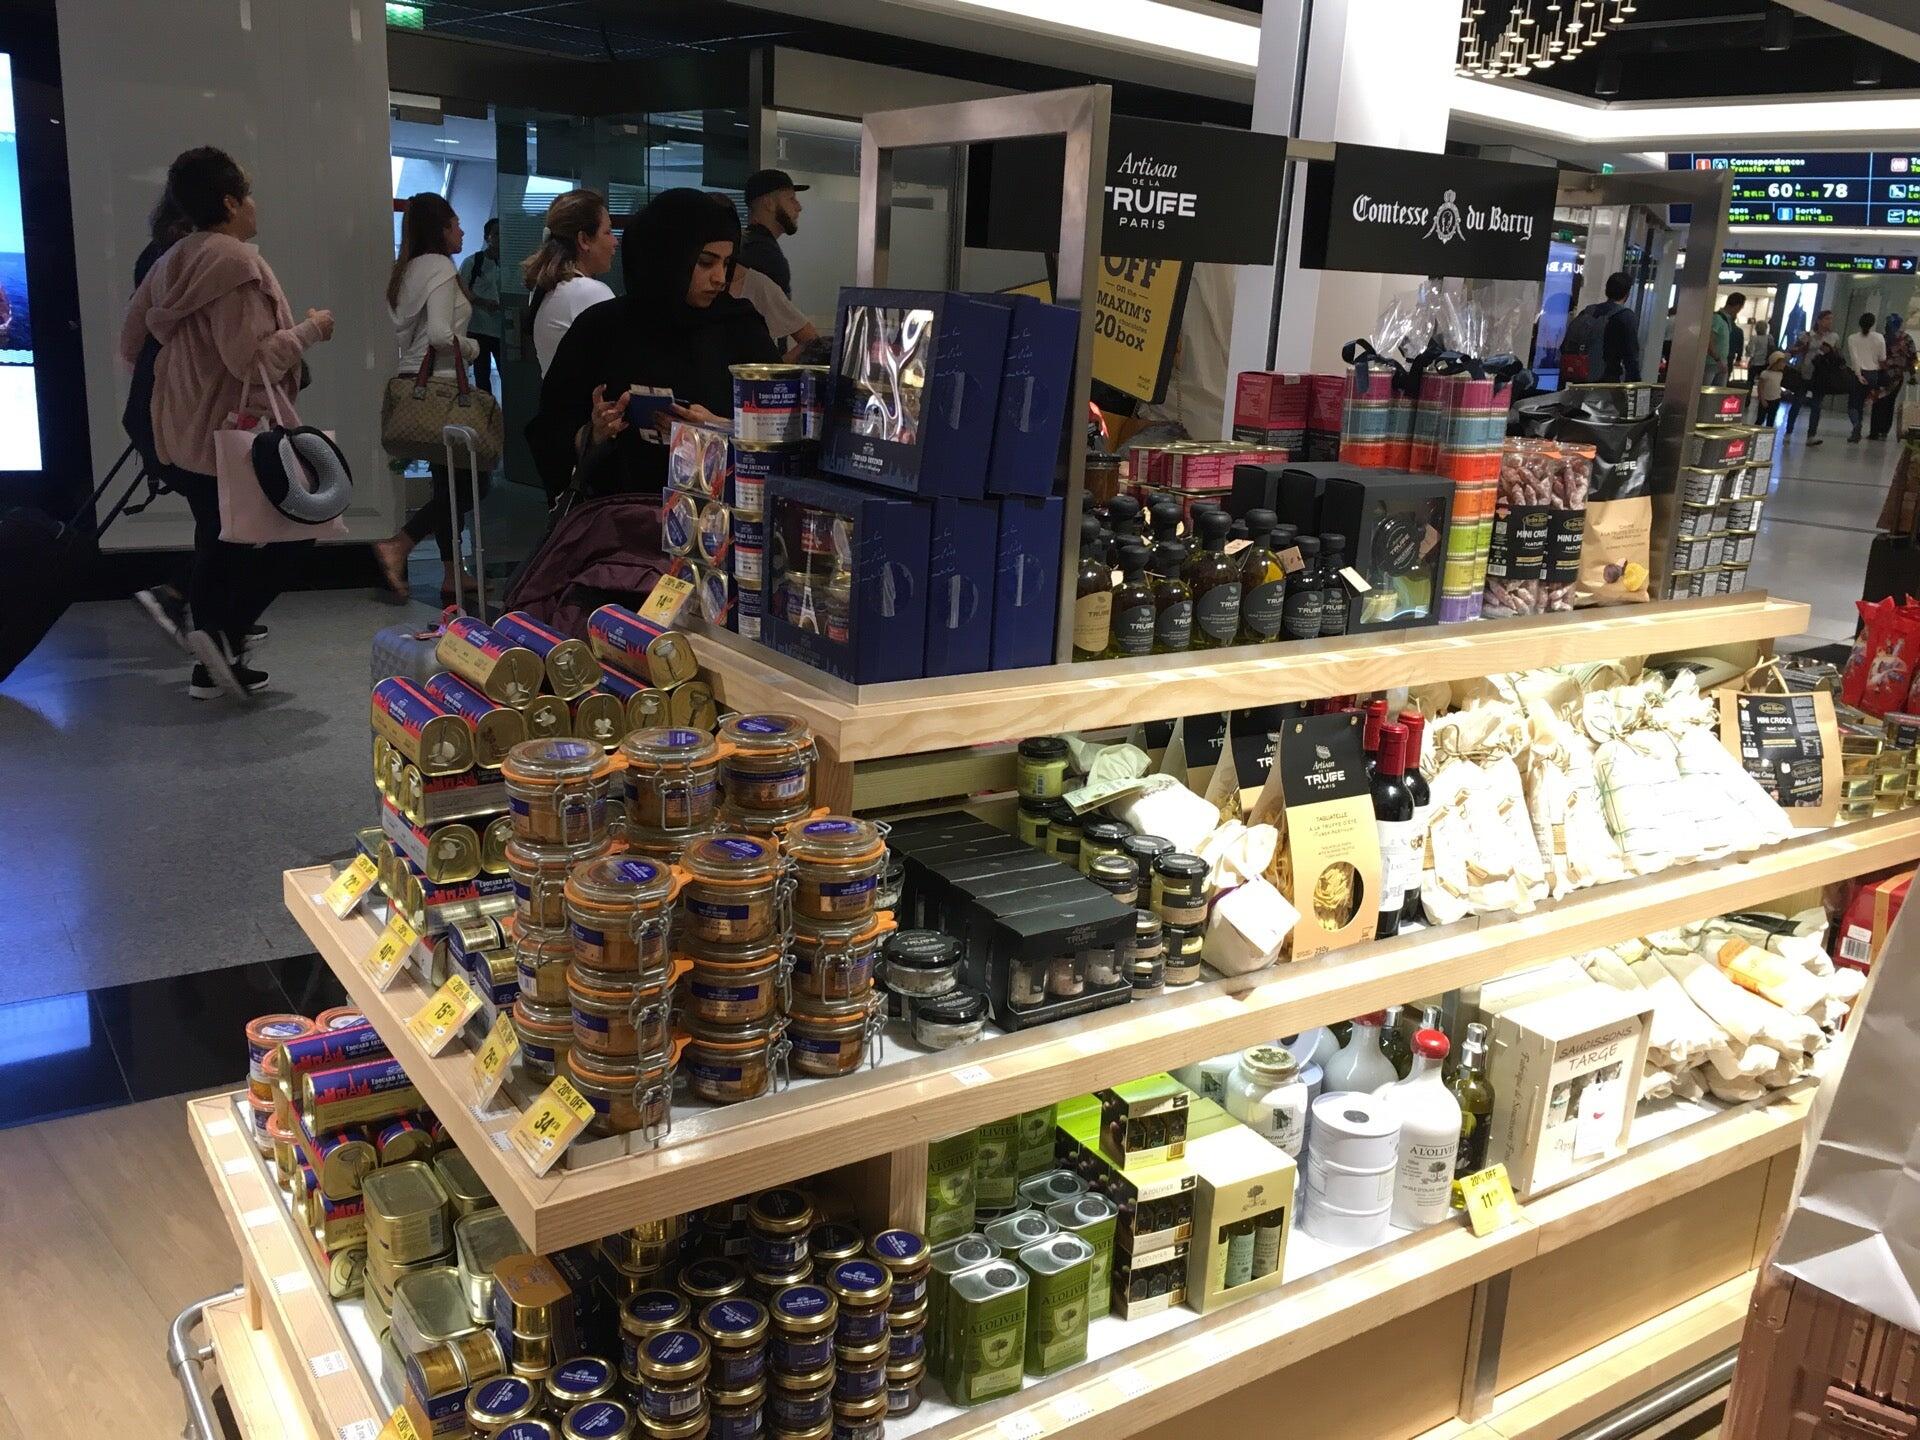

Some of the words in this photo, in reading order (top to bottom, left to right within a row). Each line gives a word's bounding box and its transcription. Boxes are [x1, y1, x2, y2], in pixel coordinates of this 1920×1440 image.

[1117, 151, 1178, 178] Artisan
[1132, 178, 1145, 186] DE
[1768, 183, 1793, 198] 60
[1822, 183, 1848, 198] 78
[1119, 217, 1165, 229] PARIS
[1352, 194, 1429, 226] Comtesse
[1466, 205, 1485, 230] du
[1488, 206, 1534, 241] Barry
[1764, 254, 1780, 265] 10
[1799, 255, 1816, 266] 38
[1116, 284, 1126, 293] on
[1097, 290, 1152, 324] MAXIM'S
[1094, 309, 1117, 338] 20
[1115, 325, 1145, 352] box
[1516, 529, 1532, 539] MINI
[1557, 534, 1572, 542] MINI
[1312, 760, 1335, 770] Artisan
[1304, 770, 1346, 786] TRUFFE
[1559, 1027, 1633, 1059] SAUCISSONS
[1570, 1043, 1618, 1070] TARGE
[569, 1094, 587, 1112] OFF
[1485, 1168, 1497, 1181] OFF
